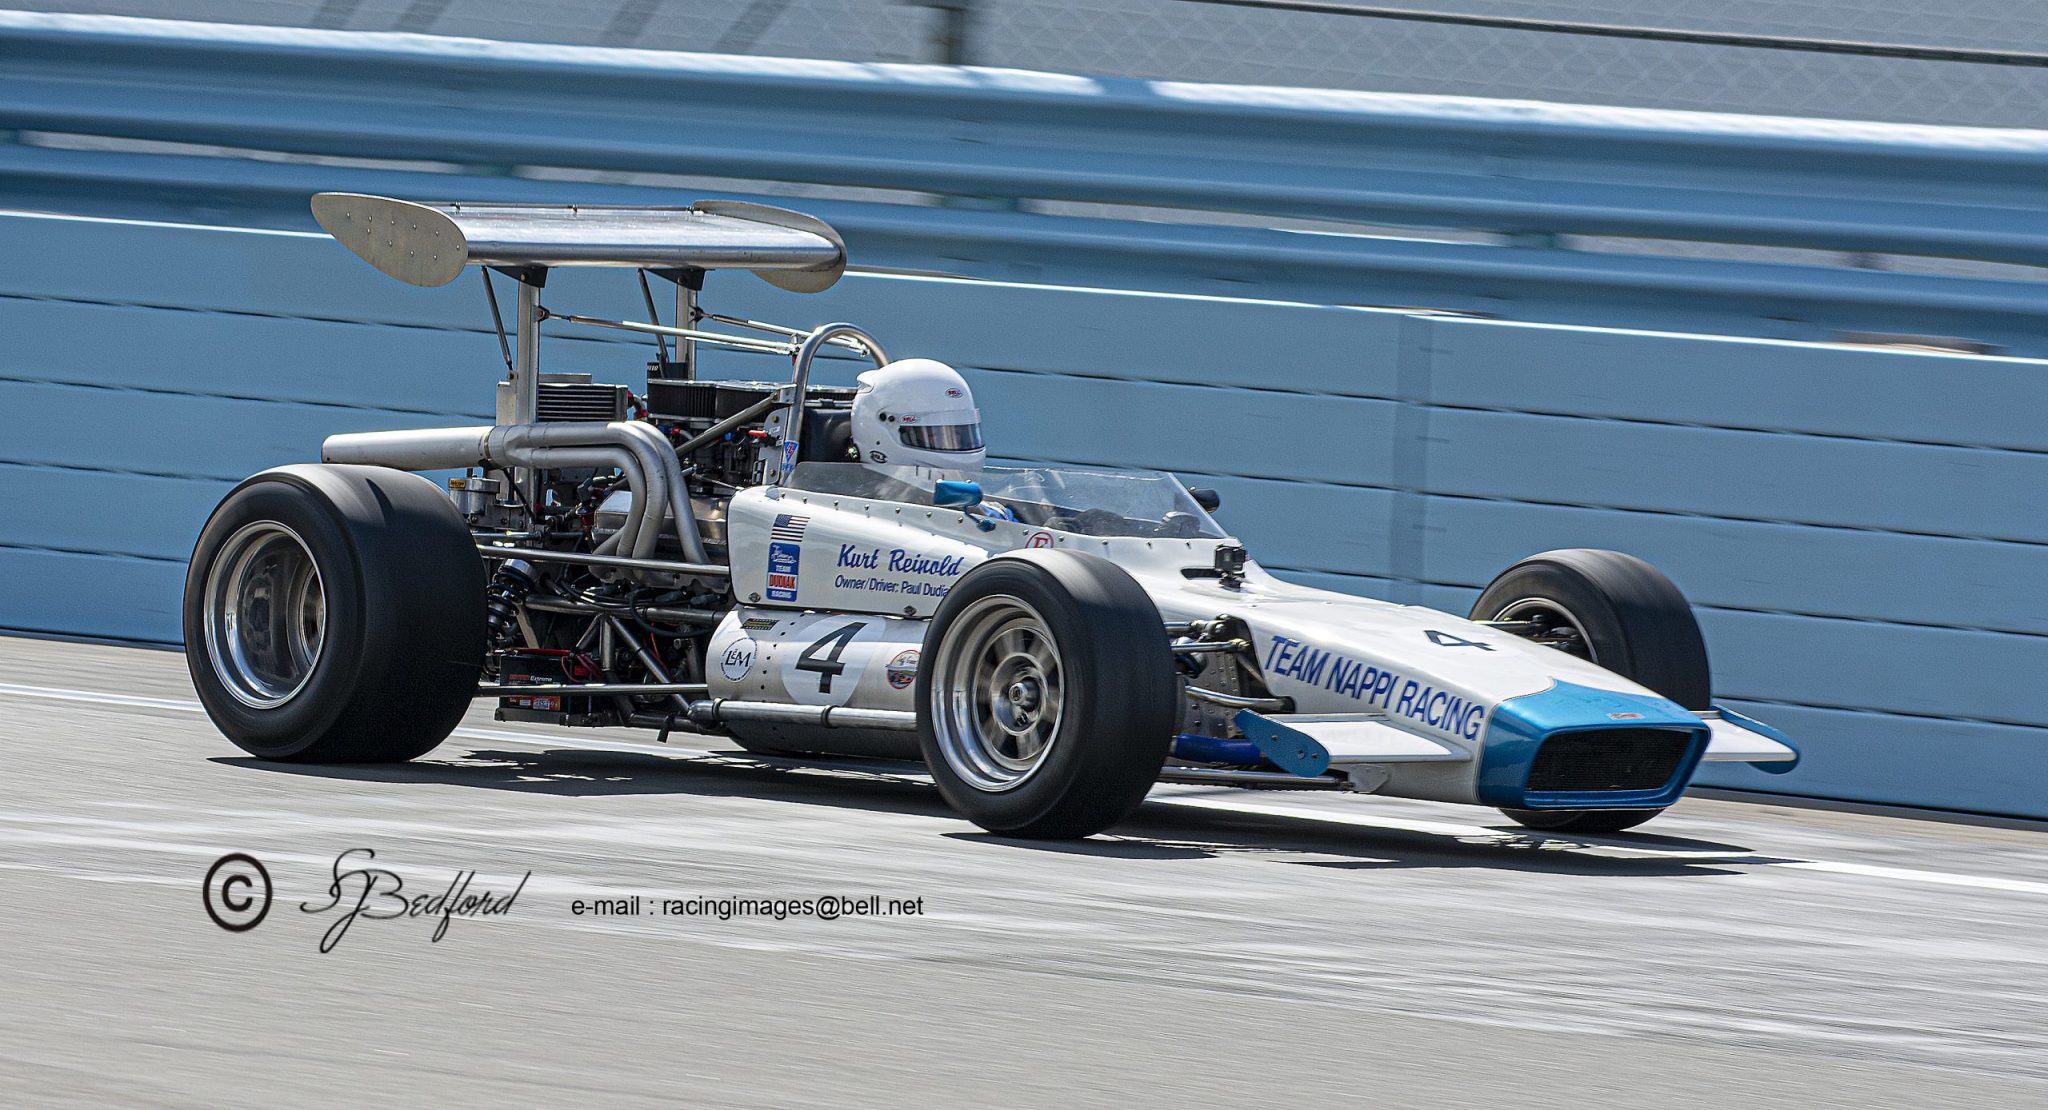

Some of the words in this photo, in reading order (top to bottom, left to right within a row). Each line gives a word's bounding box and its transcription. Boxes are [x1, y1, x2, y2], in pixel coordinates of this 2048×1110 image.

[837, 543, 880, 570] Kurt
[888, 548, 964, 577] Reinold
[769, 574, 796, 590] DUDIAK
[900, 580, 922, 596] Paul
[922, 582, 952, 598] Dudia
[1423, 629, 1498, 652] 4
[795, 621, 869, 694] 4
[1264, 635, 1330, 686] TEAM
[1324, 656, 1400, 710] NAPPI
[1395, 680, 1486, 741] RACING
